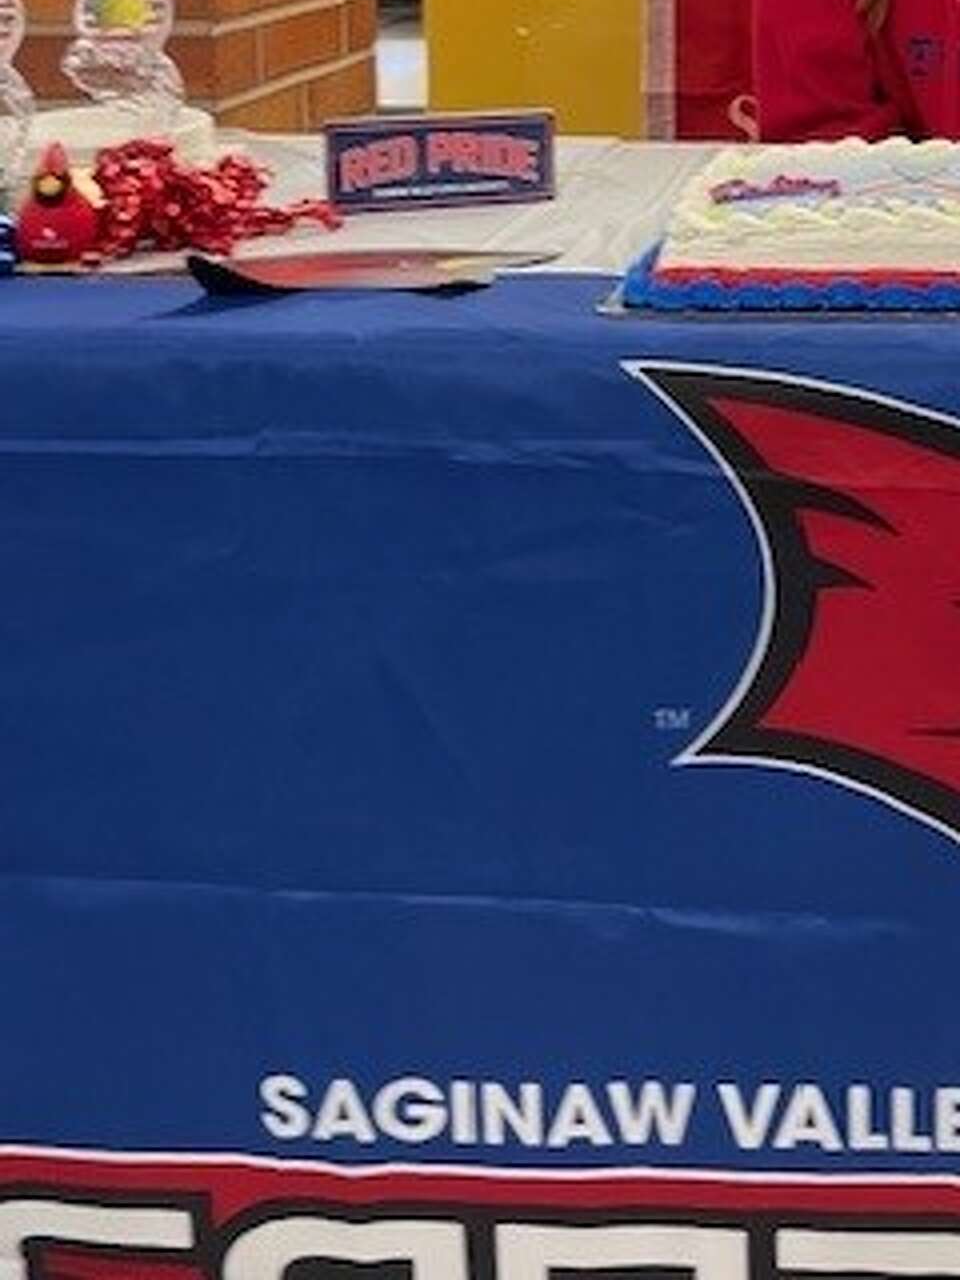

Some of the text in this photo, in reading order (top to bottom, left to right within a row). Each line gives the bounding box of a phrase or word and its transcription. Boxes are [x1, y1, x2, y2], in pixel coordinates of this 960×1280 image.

[340, 131, 540, 192] RED PRIDE
[258, 1074, 697, 1147] SAGINAW
